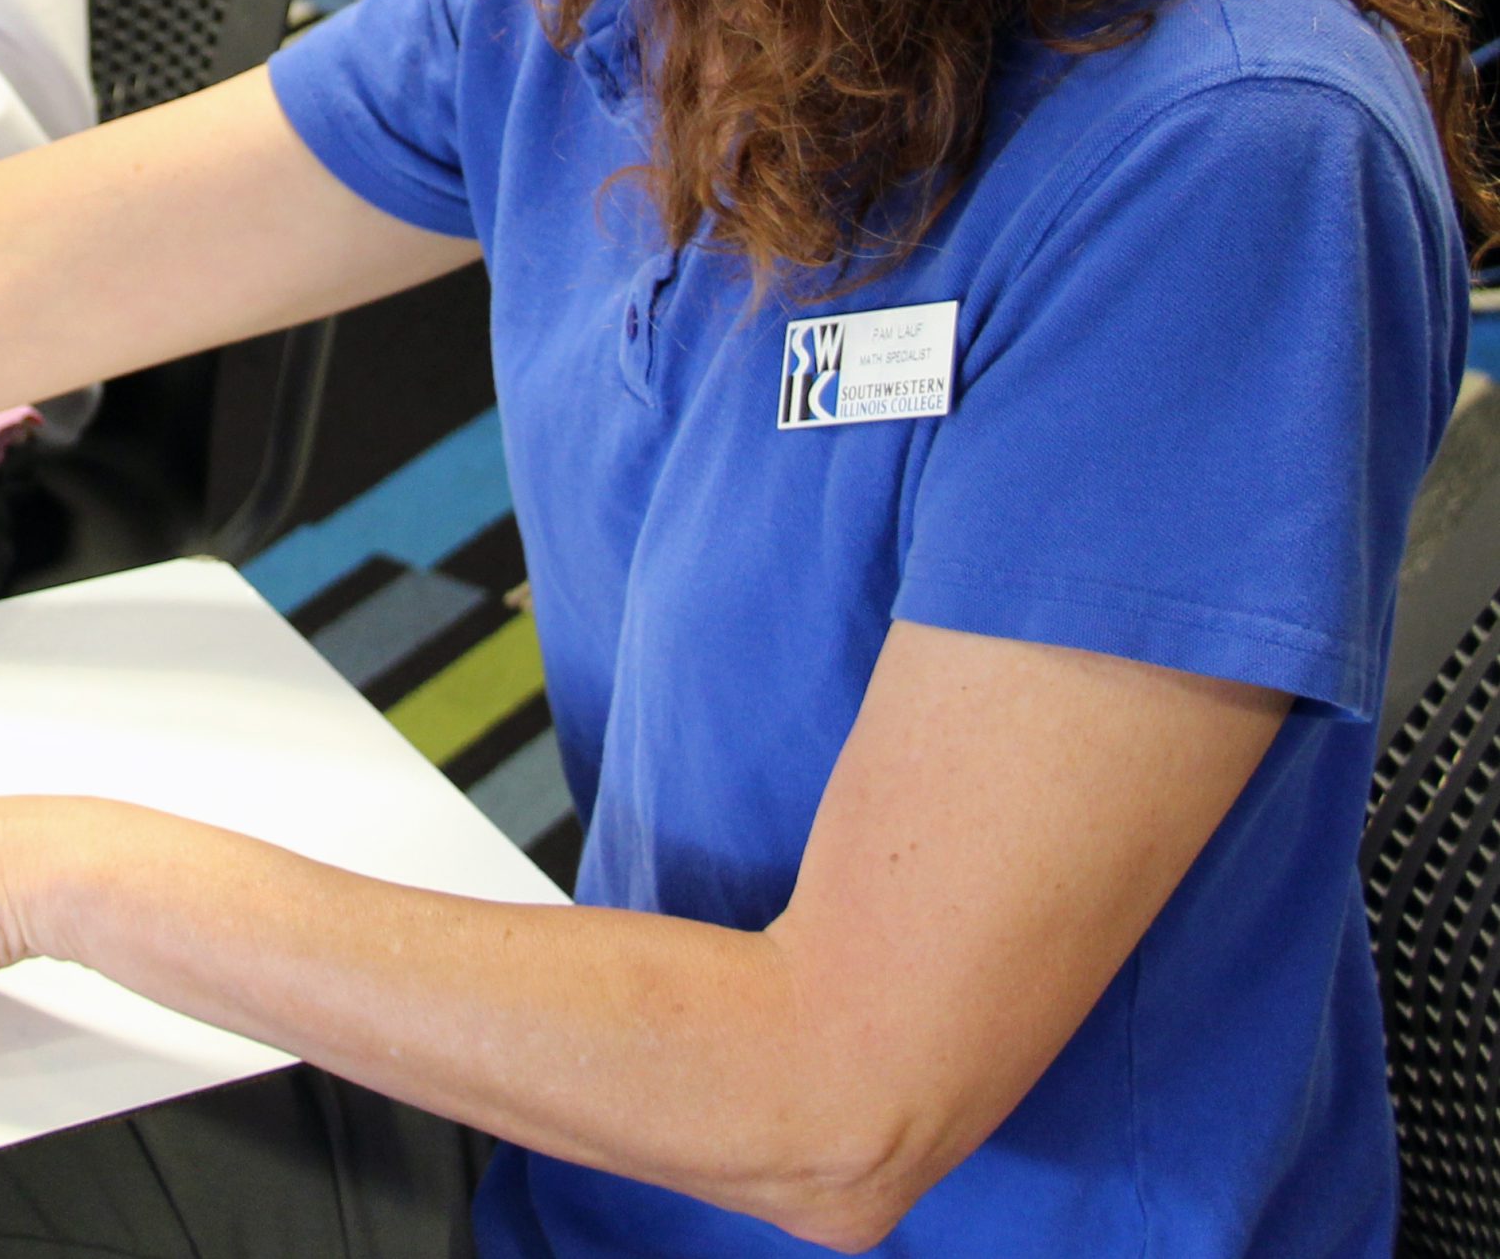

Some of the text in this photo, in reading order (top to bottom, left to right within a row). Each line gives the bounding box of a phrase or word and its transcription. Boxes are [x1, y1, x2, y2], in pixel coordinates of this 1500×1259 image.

[859, 348, 932, 366] MATH SPECIALIST
[841, 377, 945, 401] SOUTHWESTERN
[840, 394, 944, 418] ILLINOIS COLLEGE
